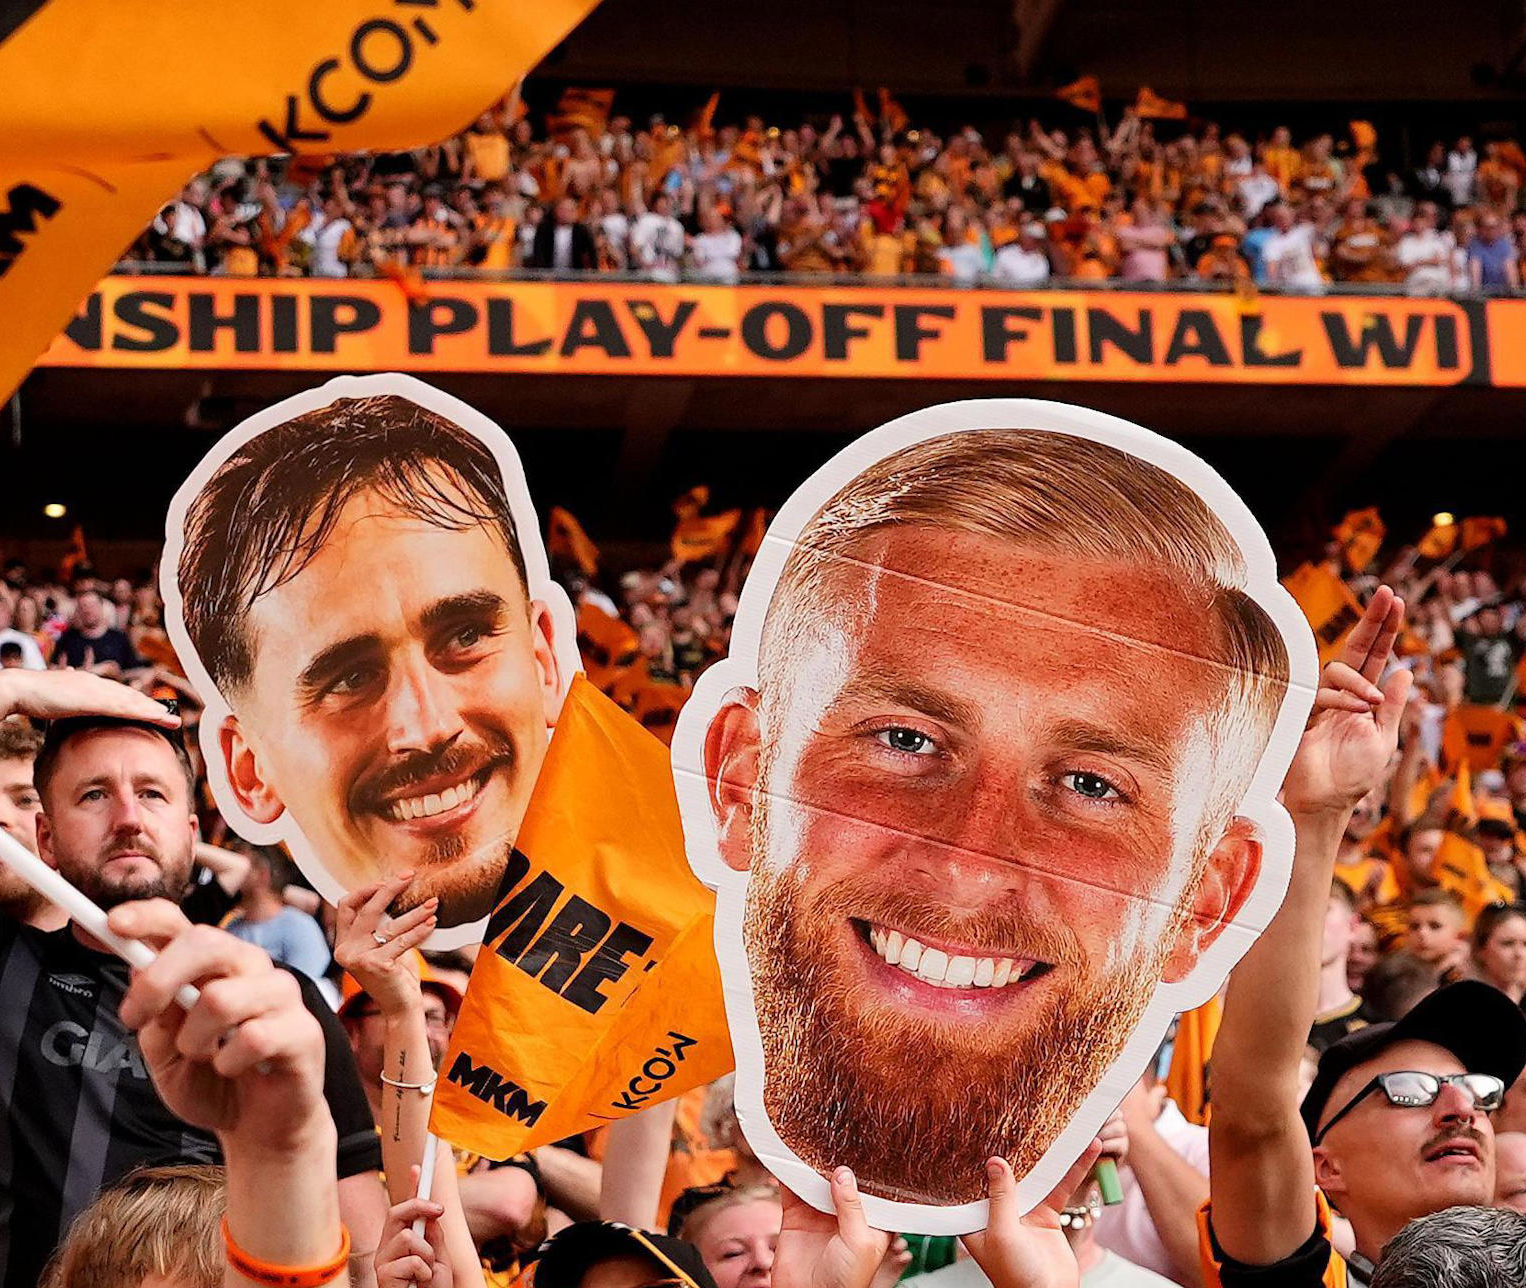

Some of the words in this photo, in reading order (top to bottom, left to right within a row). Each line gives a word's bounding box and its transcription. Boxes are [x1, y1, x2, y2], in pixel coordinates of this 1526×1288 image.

[407, 297, 956, 361] PLAY-OFF
[980, 306, 1304, 368] FINAL
[446, 1051, 549, 1129] MKM
[611, 1030, 699, 1111] KCOM
